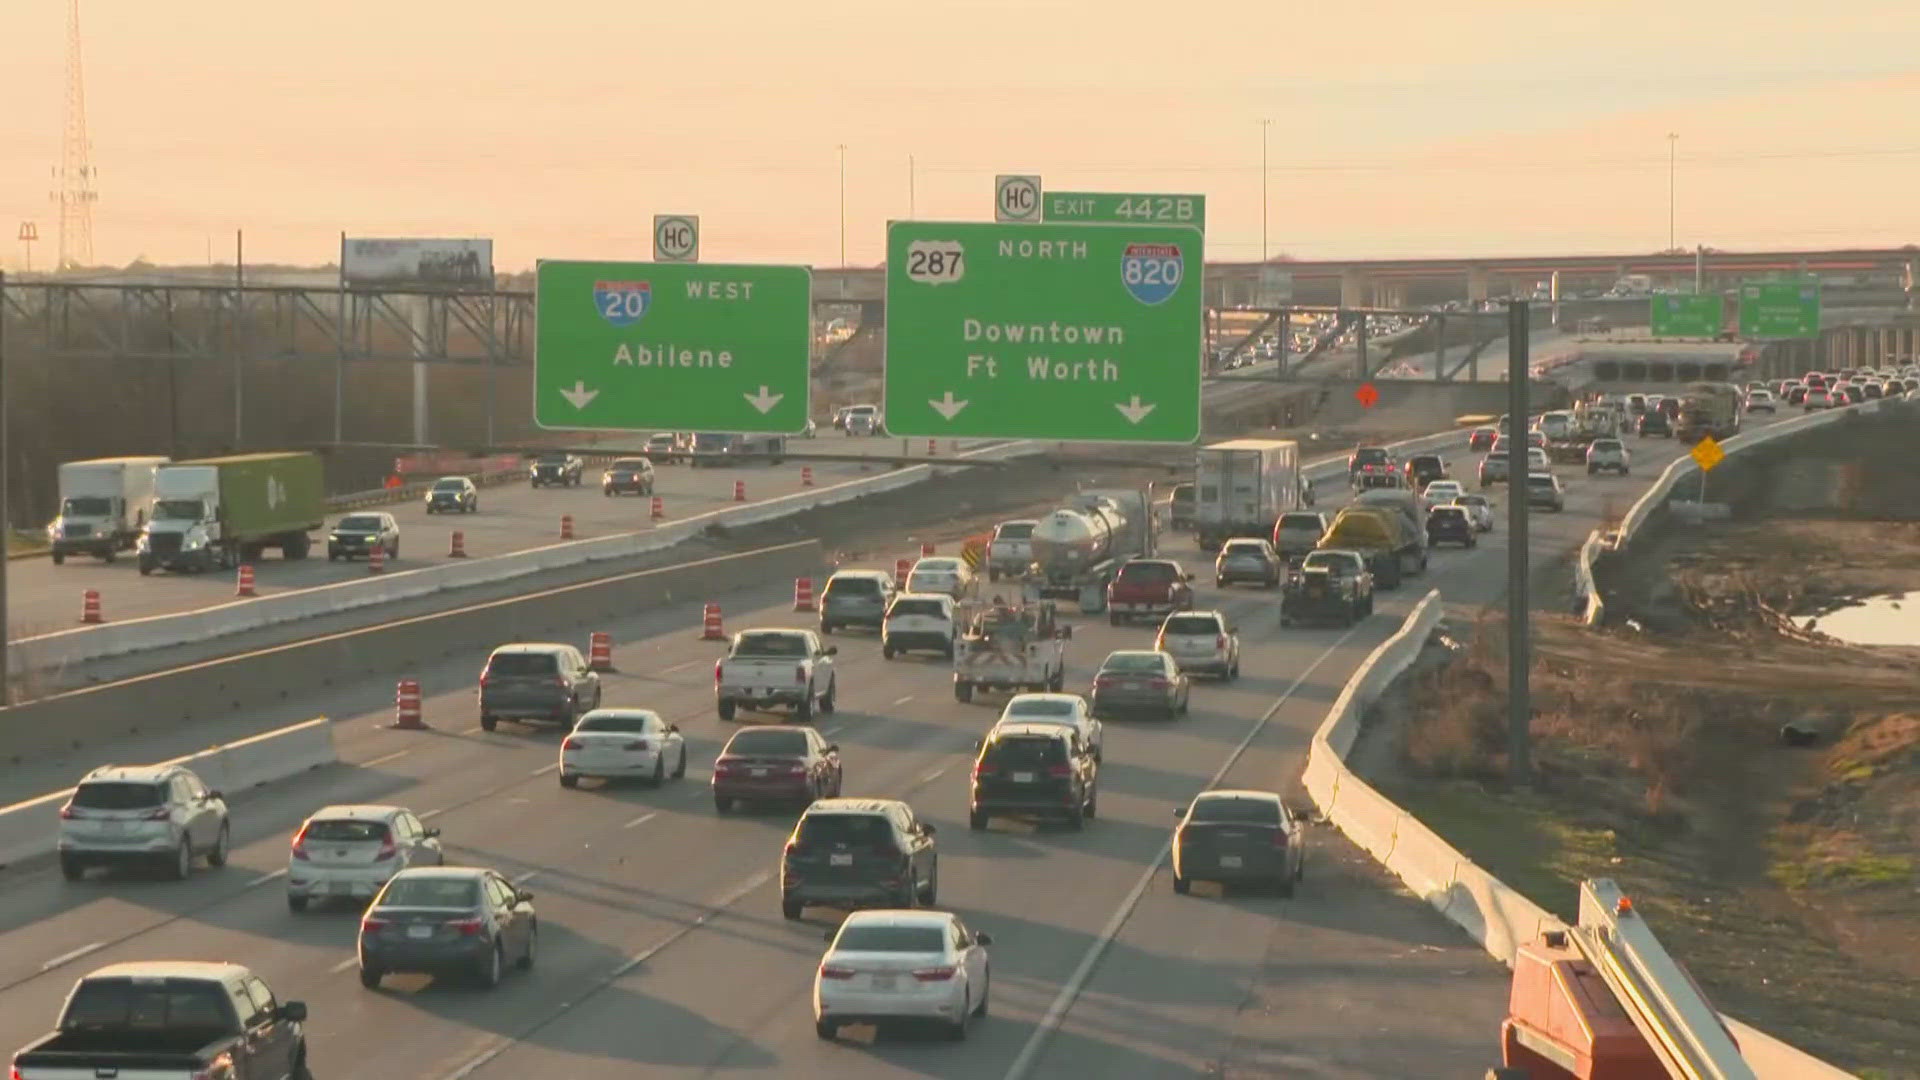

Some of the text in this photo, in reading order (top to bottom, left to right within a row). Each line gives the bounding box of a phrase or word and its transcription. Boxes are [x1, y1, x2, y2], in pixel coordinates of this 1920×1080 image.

[1006, 188, 1032, 208] HC
[1054, 199, 1194, 220] EXIT 442B
[664, 228, 690, 249] HC
[998, 240, 1088, 259] NORTH
[910, 251, 961, 275] 287
[1125, 260, 1179, 285] 820
[686, 281, 753, 299] WEST
[605, 292, 643, 317] 20
[963, 319, 1124, 344] Downtown
[613, 344, 733, 368] Abilene
[967, 356, 1120, 382] Ft Worth
